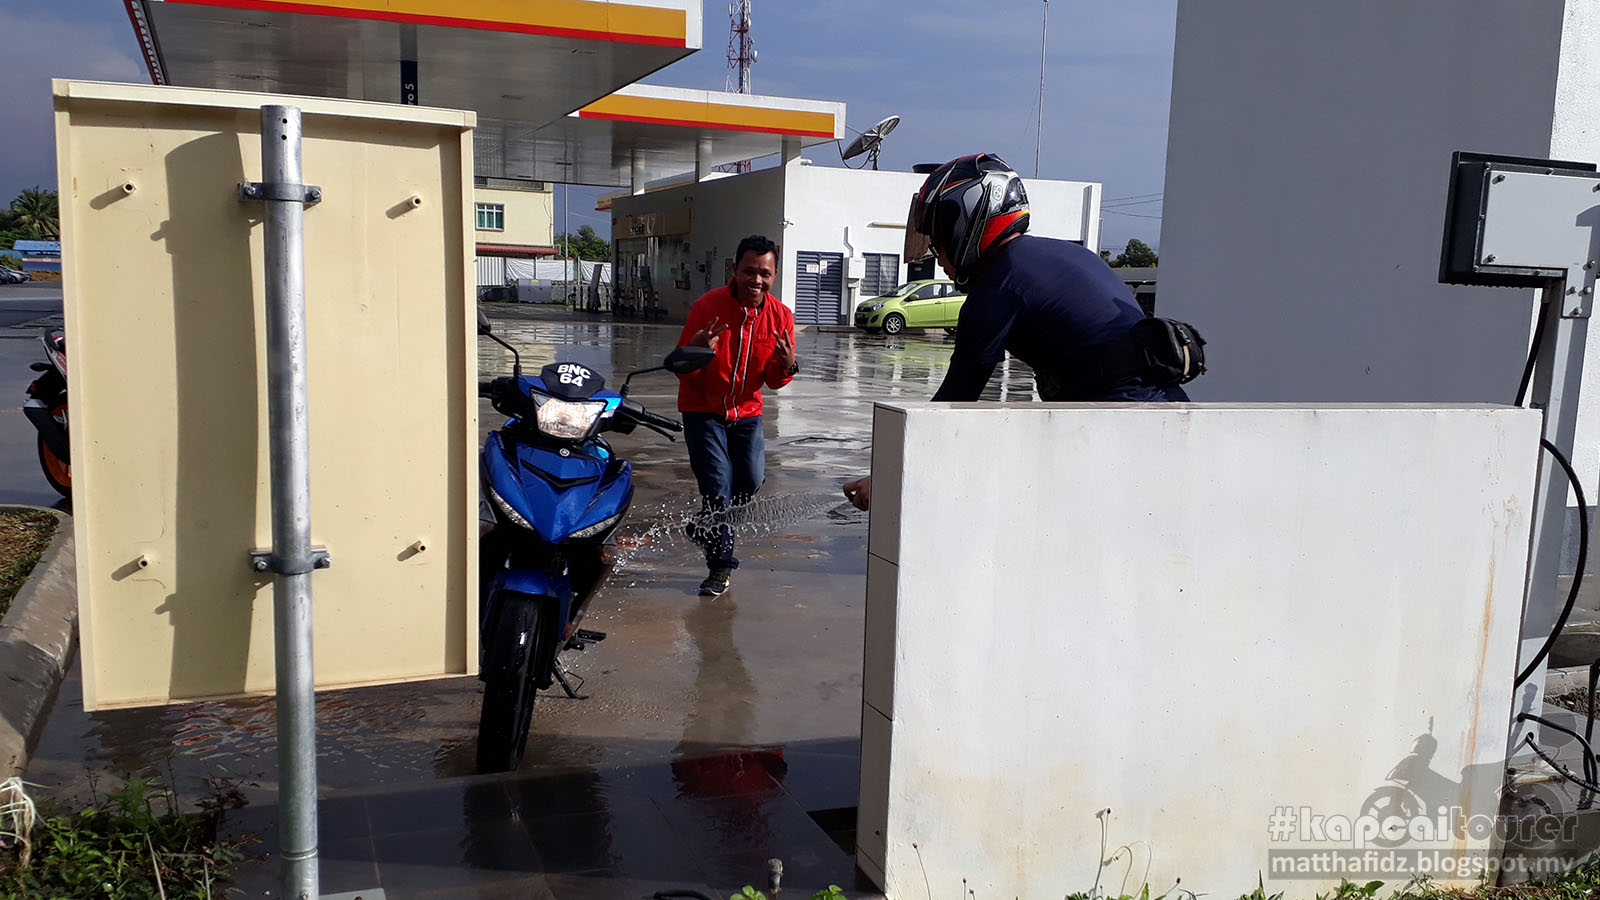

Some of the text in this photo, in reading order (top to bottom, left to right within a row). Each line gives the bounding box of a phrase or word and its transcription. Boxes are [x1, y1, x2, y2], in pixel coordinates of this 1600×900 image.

[404, 83, 415, 91] 5
[557, 364, 592, 379] BNC
[559, 373, 583, 387] 64
